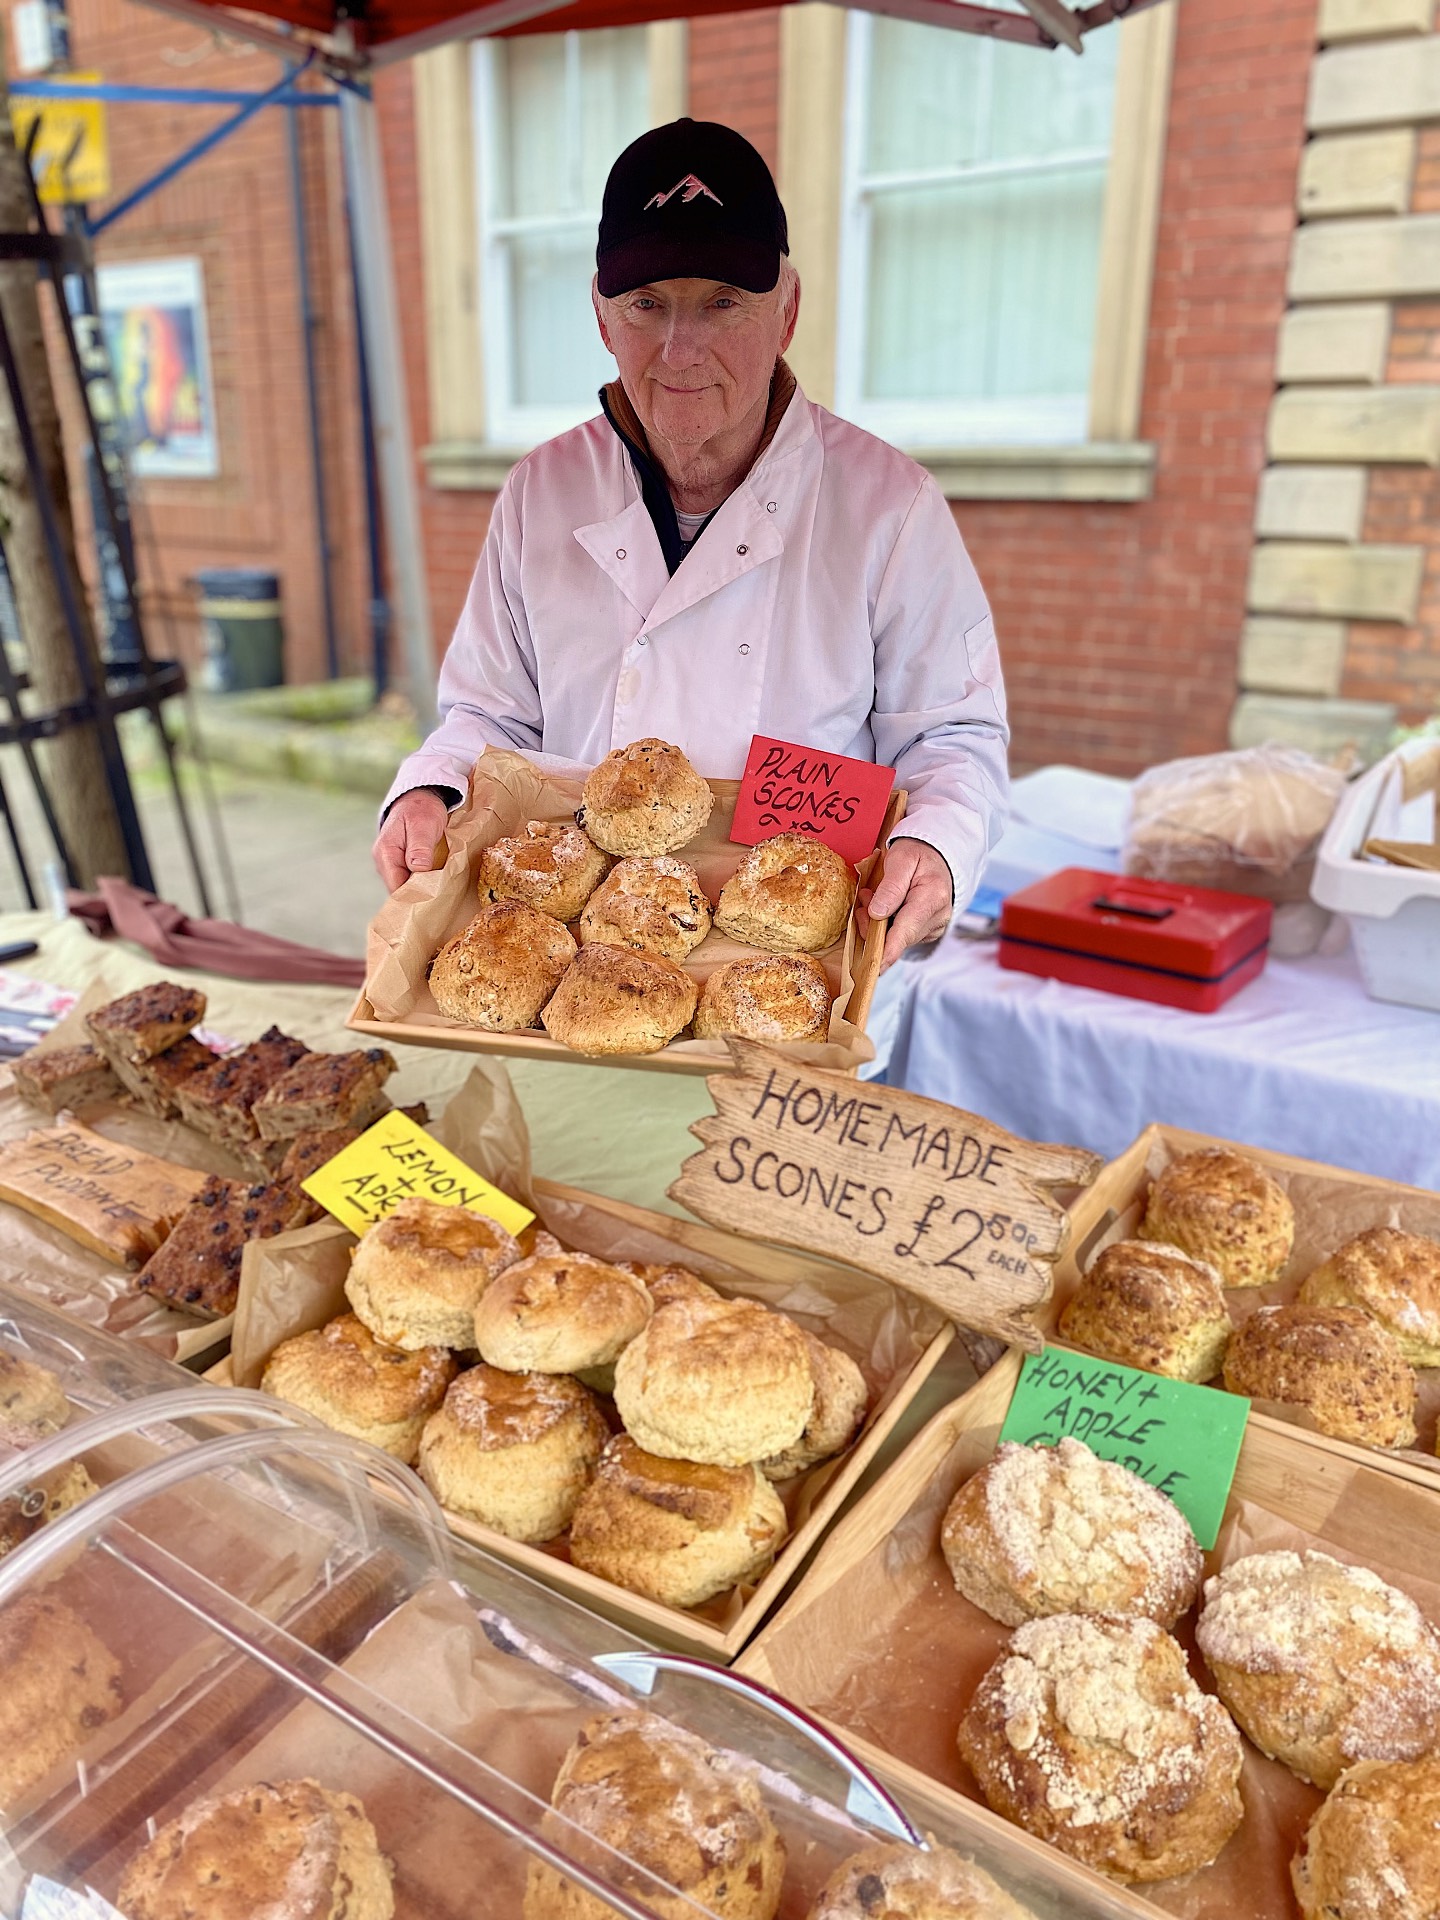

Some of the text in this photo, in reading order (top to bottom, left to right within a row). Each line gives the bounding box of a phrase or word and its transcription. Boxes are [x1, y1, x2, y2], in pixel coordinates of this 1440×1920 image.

[755, 747, 843, 787] PLAIN
[753, 781, 860, 824] SCONES
[36, 1132, 134, 1176] BREAD
[381, 1138, 486, 1205] LEMON
[341, 1173, 404, 1212] APR
[714, 1137, 892, 1235] SCONES
[987, 1250, 1028, 1274] EACH
[1044, 1396, 1166, 1445] APPLE
